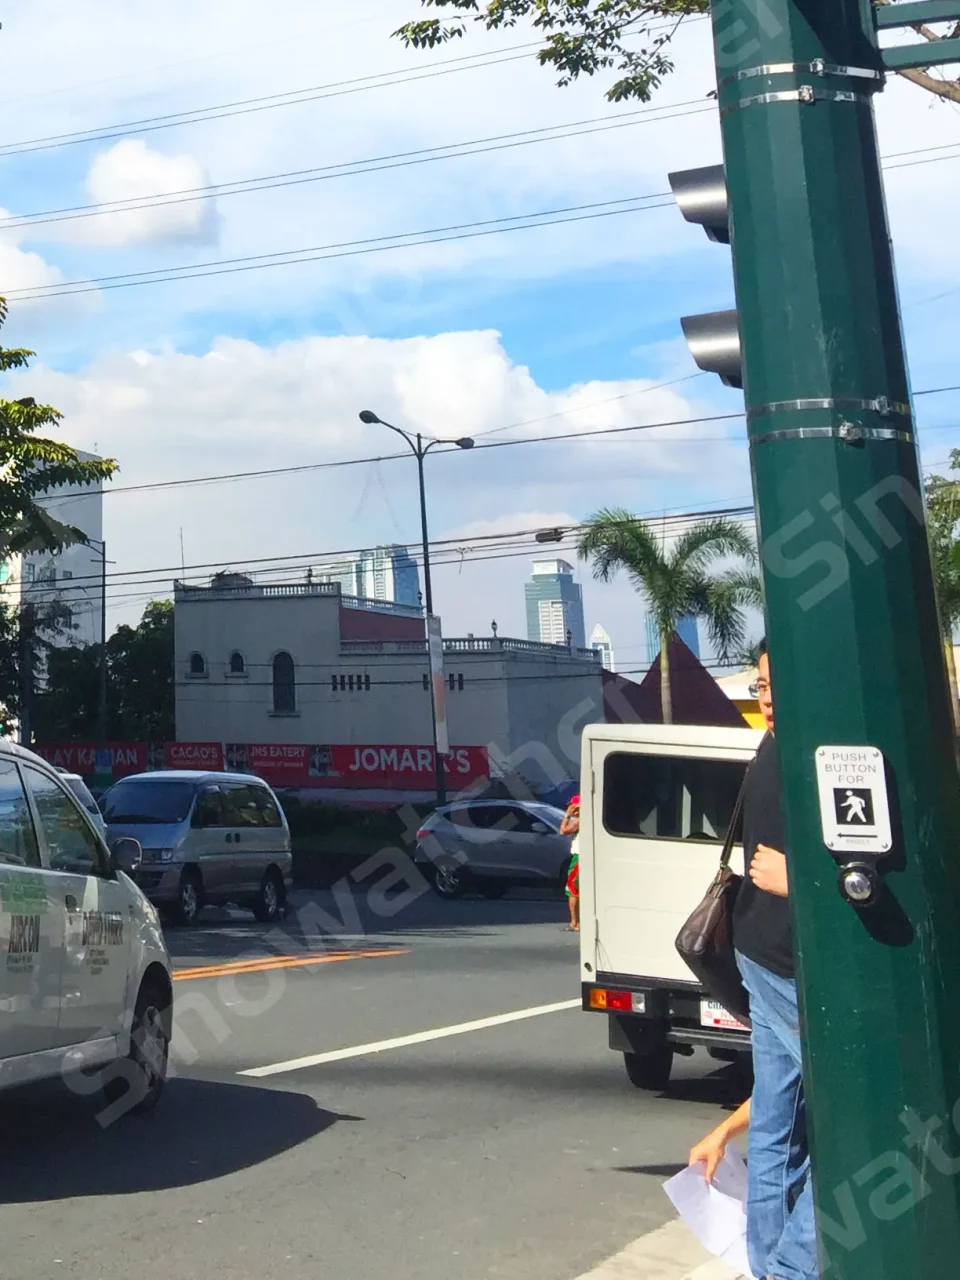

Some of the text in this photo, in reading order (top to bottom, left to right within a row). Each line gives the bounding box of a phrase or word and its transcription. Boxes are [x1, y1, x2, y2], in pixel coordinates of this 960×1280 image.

[170, 746, 218, 759] CACAO'S
[269, 746, 306, 758] EATERY
[832, 752, 867, 762] PUSH
[825, 763, 877, 773] BUTTON
[838, 775, 865, 785] FOR
